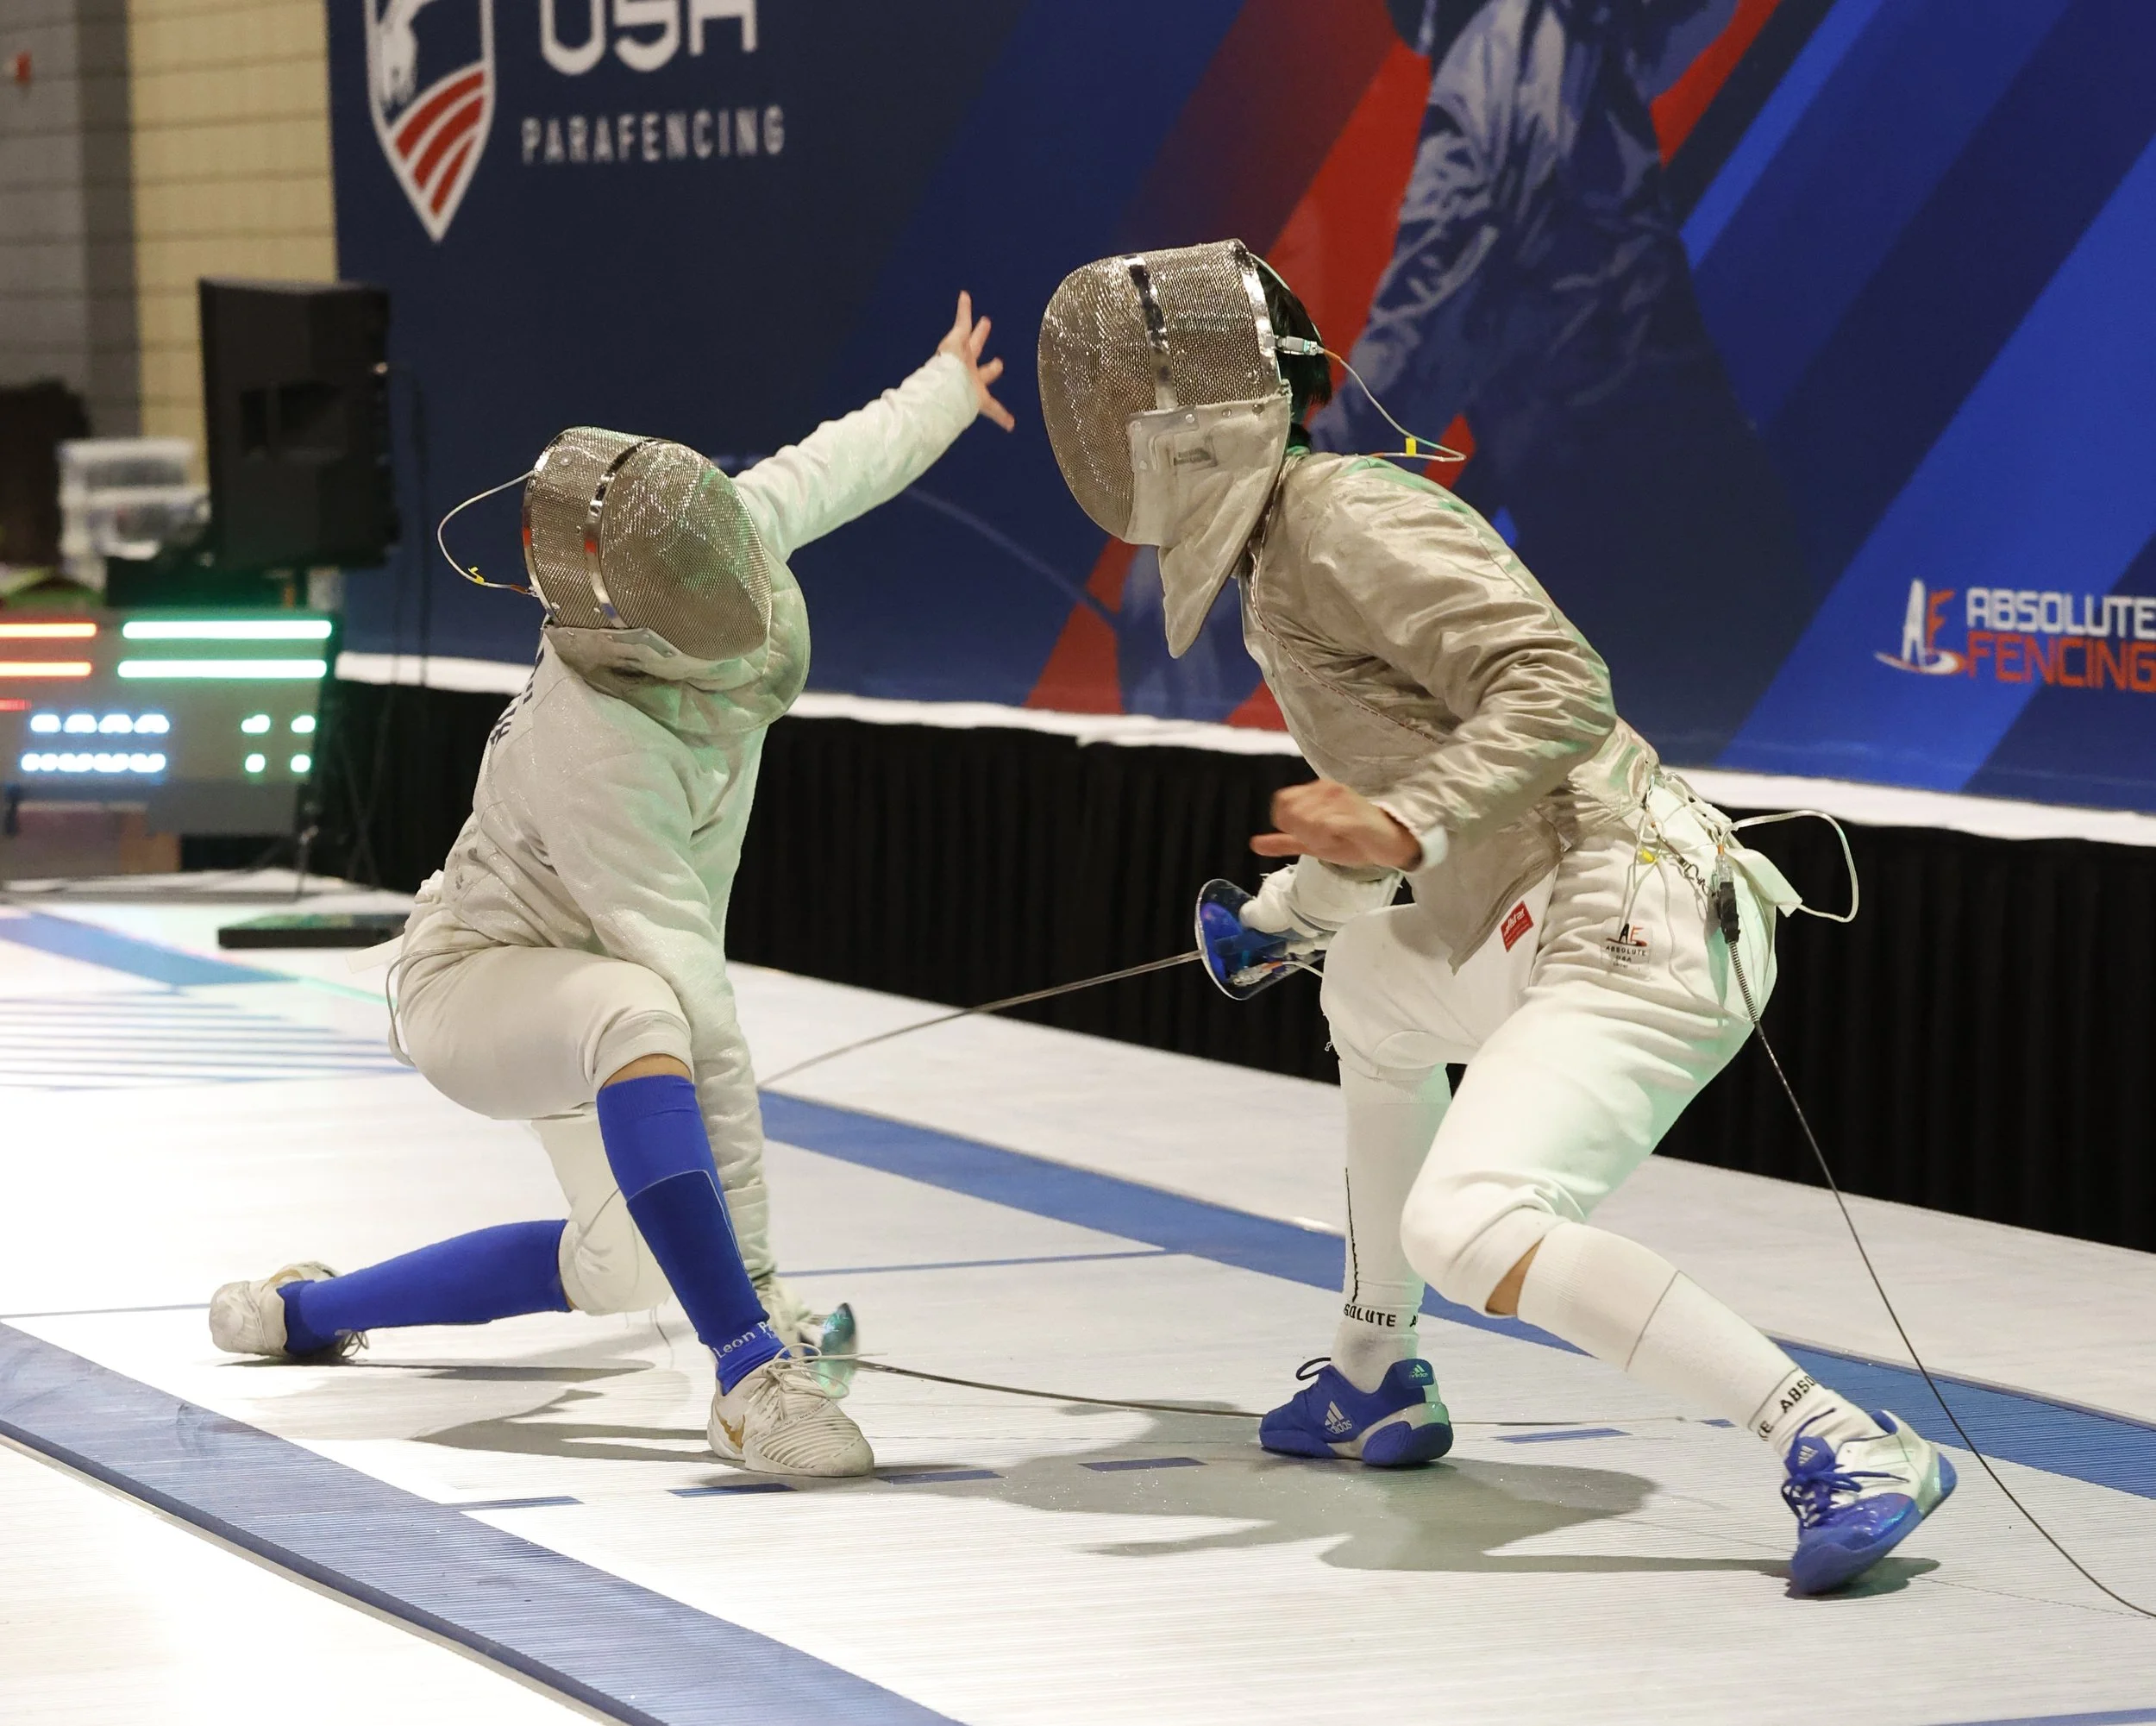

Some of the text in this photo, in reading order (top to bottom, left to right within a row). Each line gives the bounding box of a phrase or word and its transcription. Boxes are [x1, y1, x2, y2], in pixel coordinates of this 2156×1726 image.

[521, 104, 785, 165] PARAFENCING
[1965, 586, 2156, 639] ABSOLUTE
[1966, 630, 2156, 694] FENCING
[1605, 945, 1646, 957] ABSOLUTE
[712, 1331, 757, 1359] Leon
